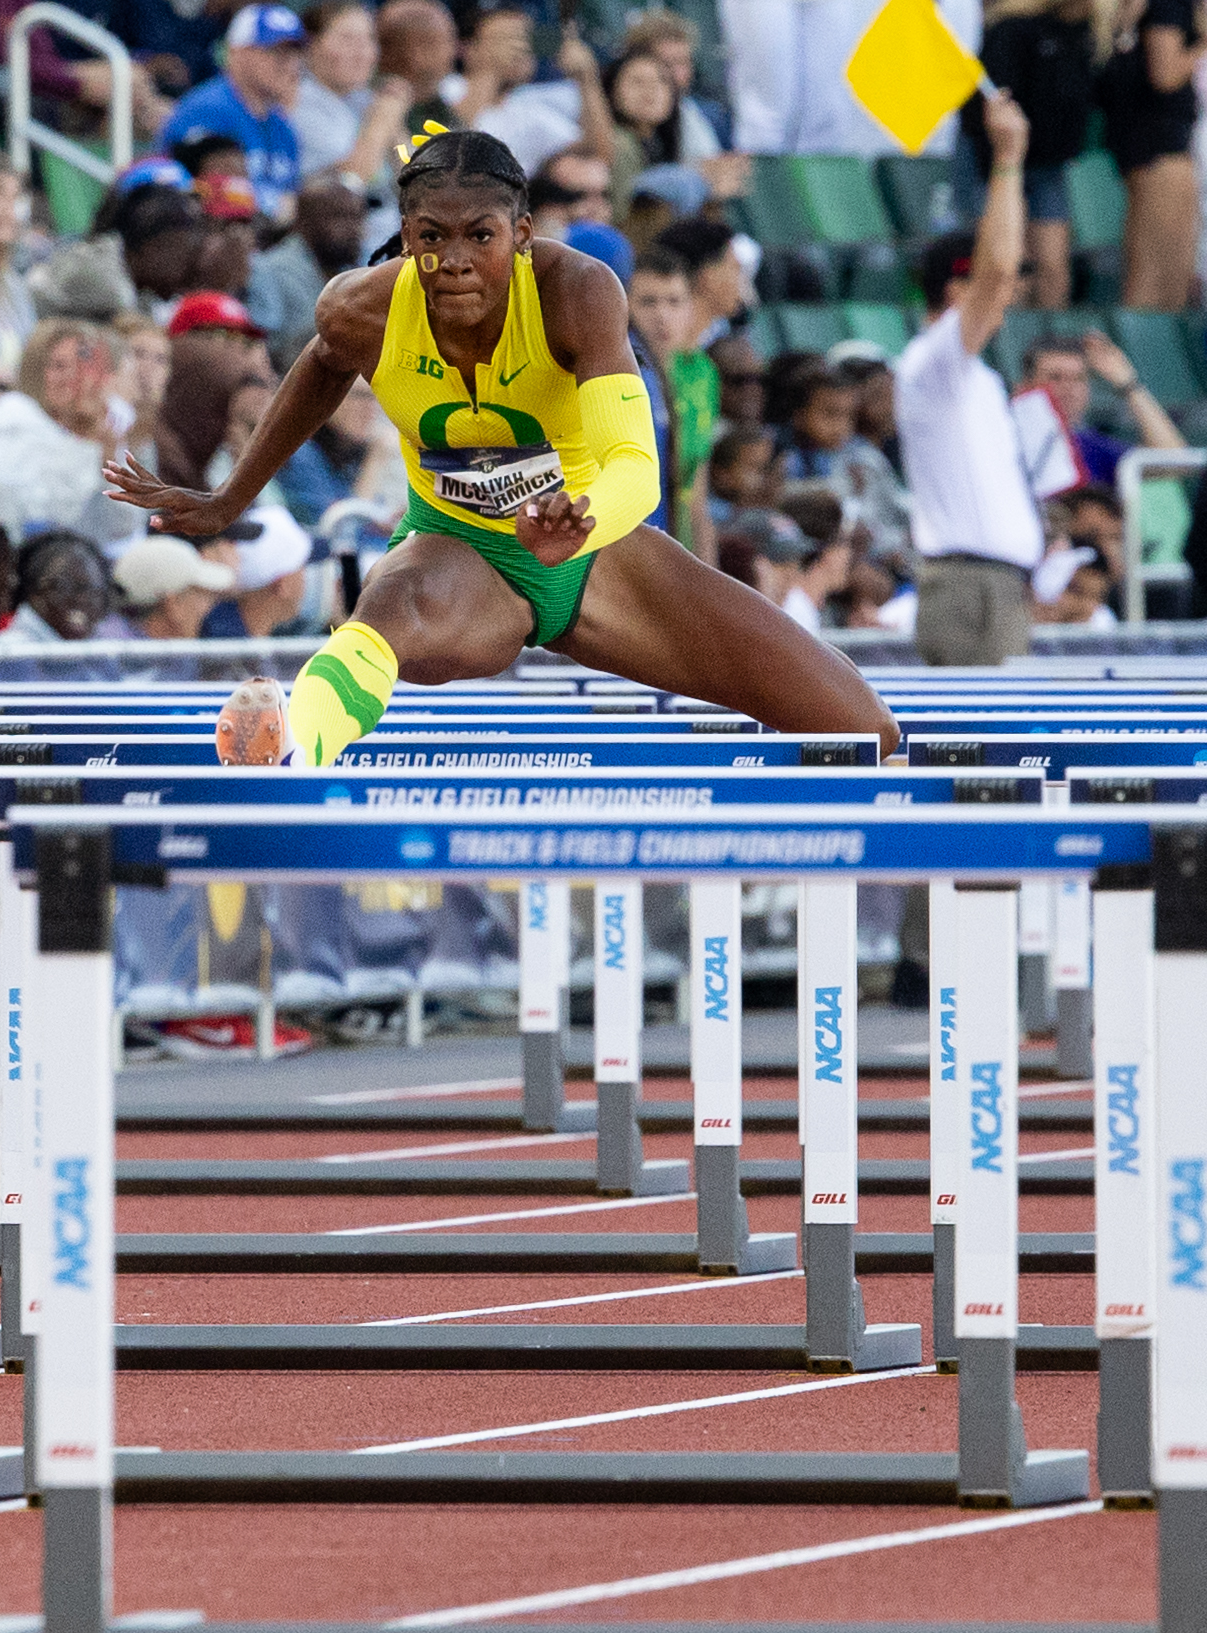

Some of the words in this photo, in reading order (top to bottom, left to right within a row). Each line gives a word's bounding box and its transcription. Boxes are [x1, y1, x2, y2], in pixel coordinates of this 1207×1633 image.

[420, 253, 439, 273] O
[441, 469, 558, 509] MCCRMICK
[375, 753, 427, 767] FIELD
[431, 753, 593, 768] CHAMPIONSHIPS
[732, 756, 766, 767] GILL
[1019, 756, 1051, 767] GILL
[366, 787, 438, 807] TRACK
[525, 787, 713, 807] CHAMPIONSHIPS
[604, 895, 625, 970] NCAA
[705, 936, 728, 1021] NCAA
[815, 986, 843, 1084] NCAA
[701, 1119, 732, 1128] GILL
[971, 1062, 1002, 1174] NCAA
[1108, 1064, 1139, 1175] NCAA
[812, 1194, 847, 1205] GILL
[937, 1195, 957, 1206] GI
[53, 1159, 90, 1290] NCAA
